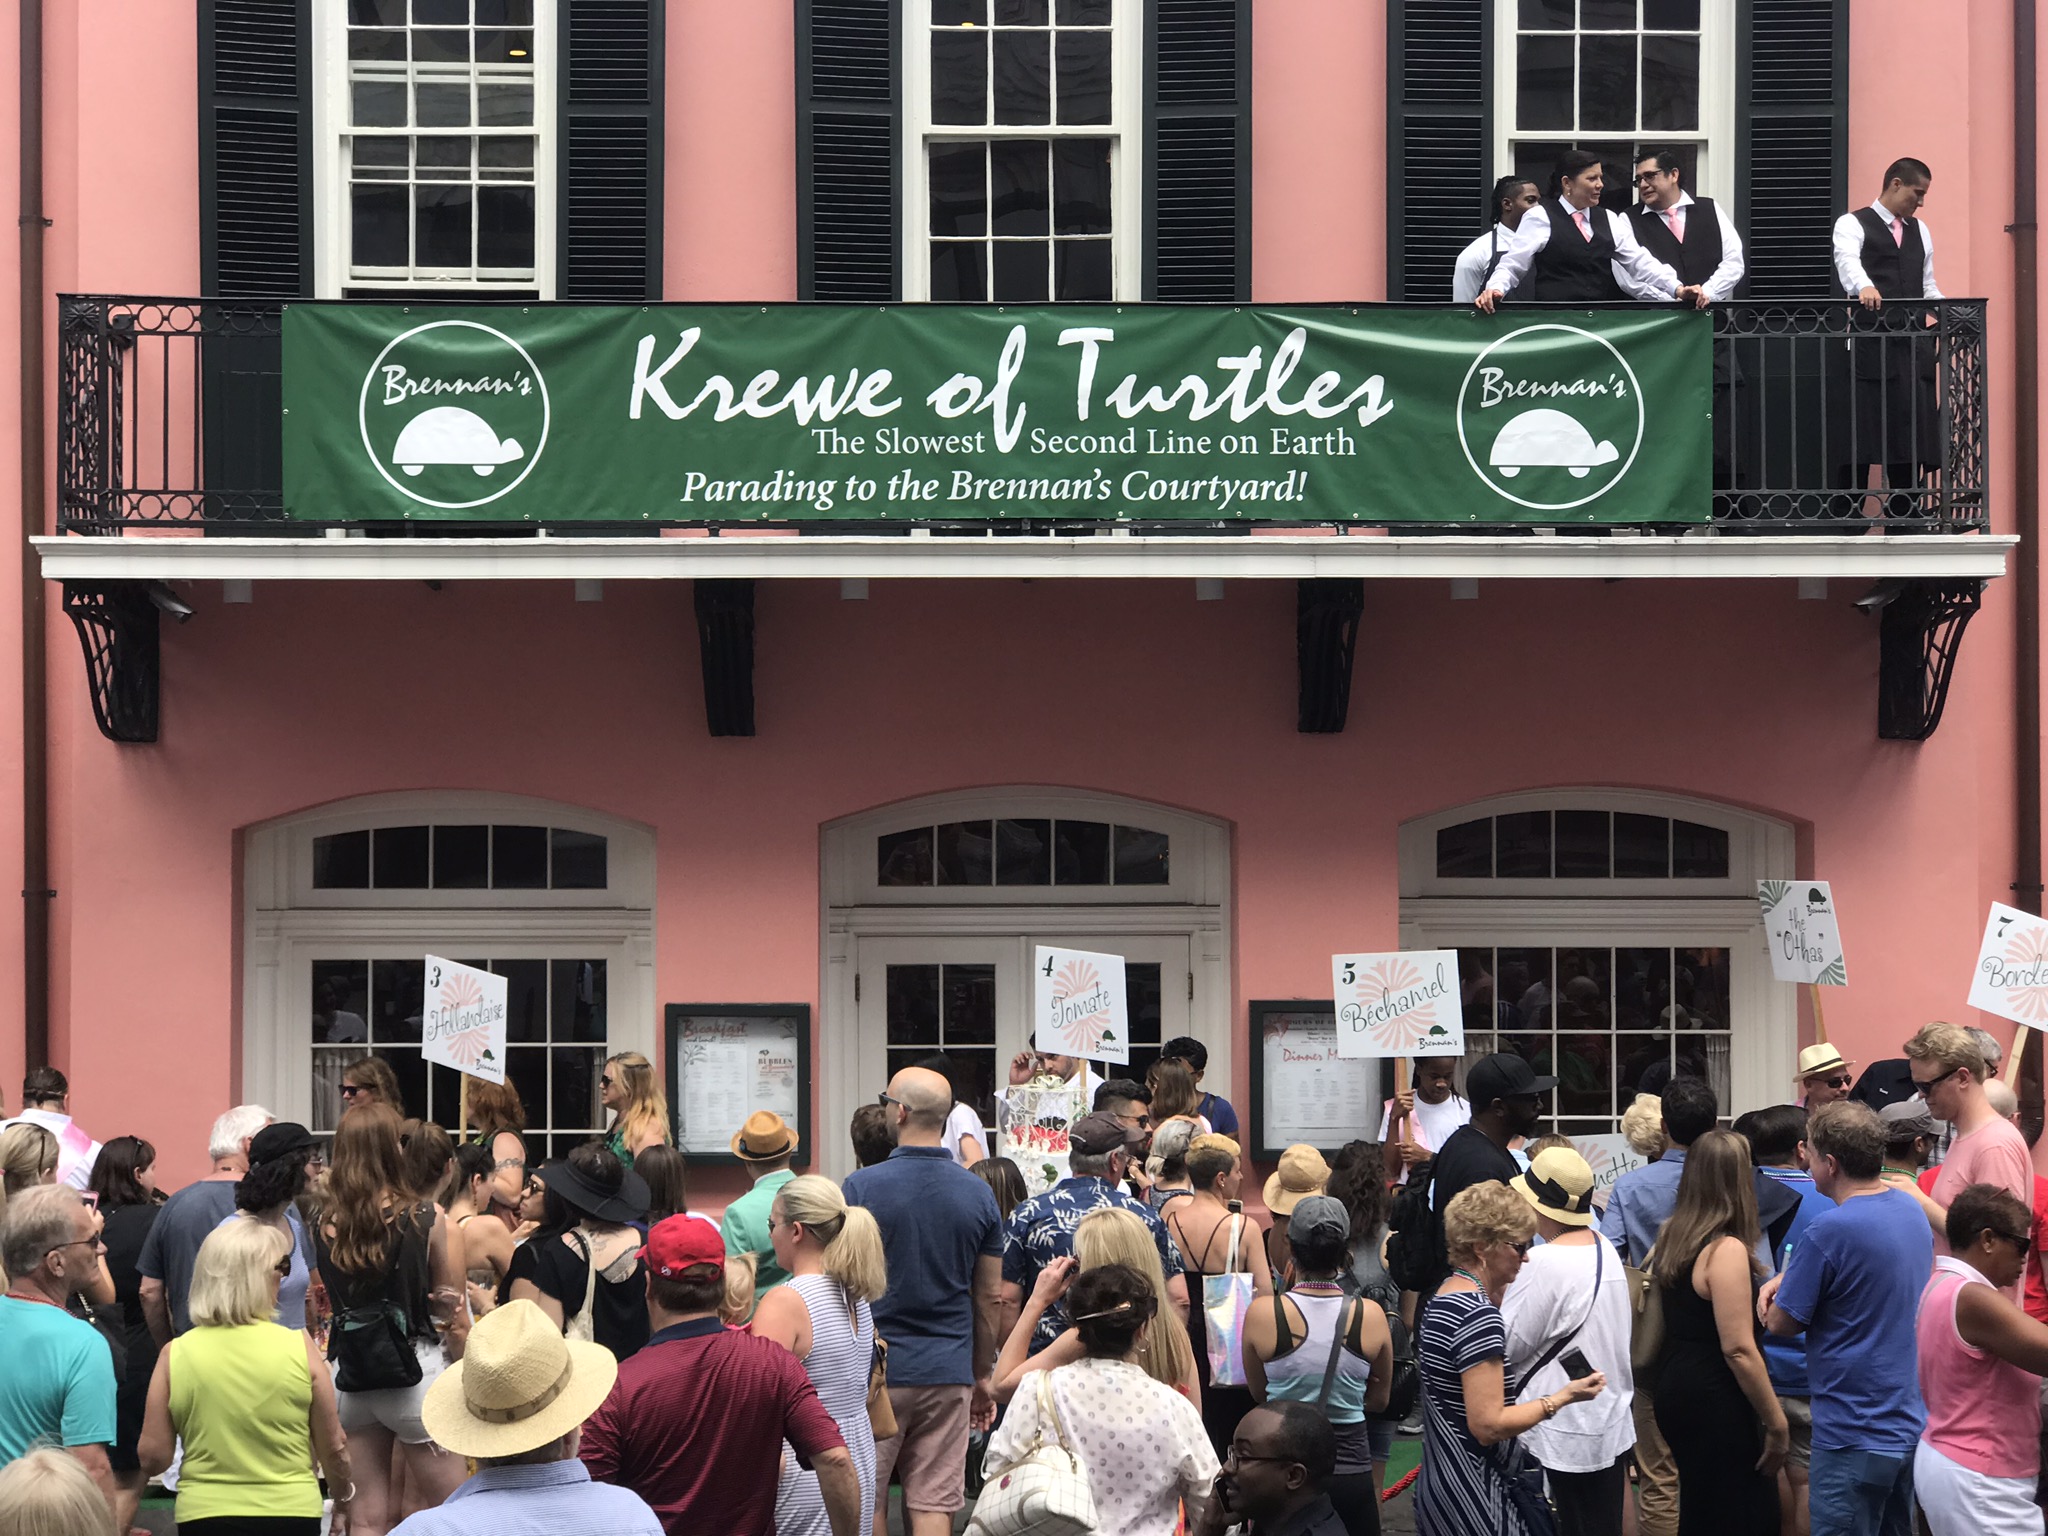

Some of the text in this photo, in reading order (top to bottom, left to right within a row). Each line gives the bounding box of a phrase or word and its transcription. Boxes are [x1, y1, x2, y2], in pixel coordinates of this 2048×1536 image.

[381, 364, 533, 406] Brennan's
[629, 324, 1394, 454] Krewe of Turtles
[1479, 366, 1627, 408] Brennan's
[811, 426, 986, 455] The Slowest
[1030, 426, 1357, 456] Second Line on Earth
[679, 467, 1309, 511] Parading to the Brennan's Courtyard!
[1788, 907, 1807, 932] the
[1997, 915, 2015, 938] 7
[430, 965, 442, 988] 3
[1041, 955, 1054, 978] 4
[1341, 962, 1357, 985] 5
[1051, 981, 1111, 1029] Tomate
[1340, 962, 1449, 1033] Béchamel
[425, 994, 505, 1041] Hollandaise
[1095, 1041, 1124, 1054] Brennan's
[1282, 1048, 1323, 1062] Dinner
[1418, 1038, 1458, 1050] Brennan's
